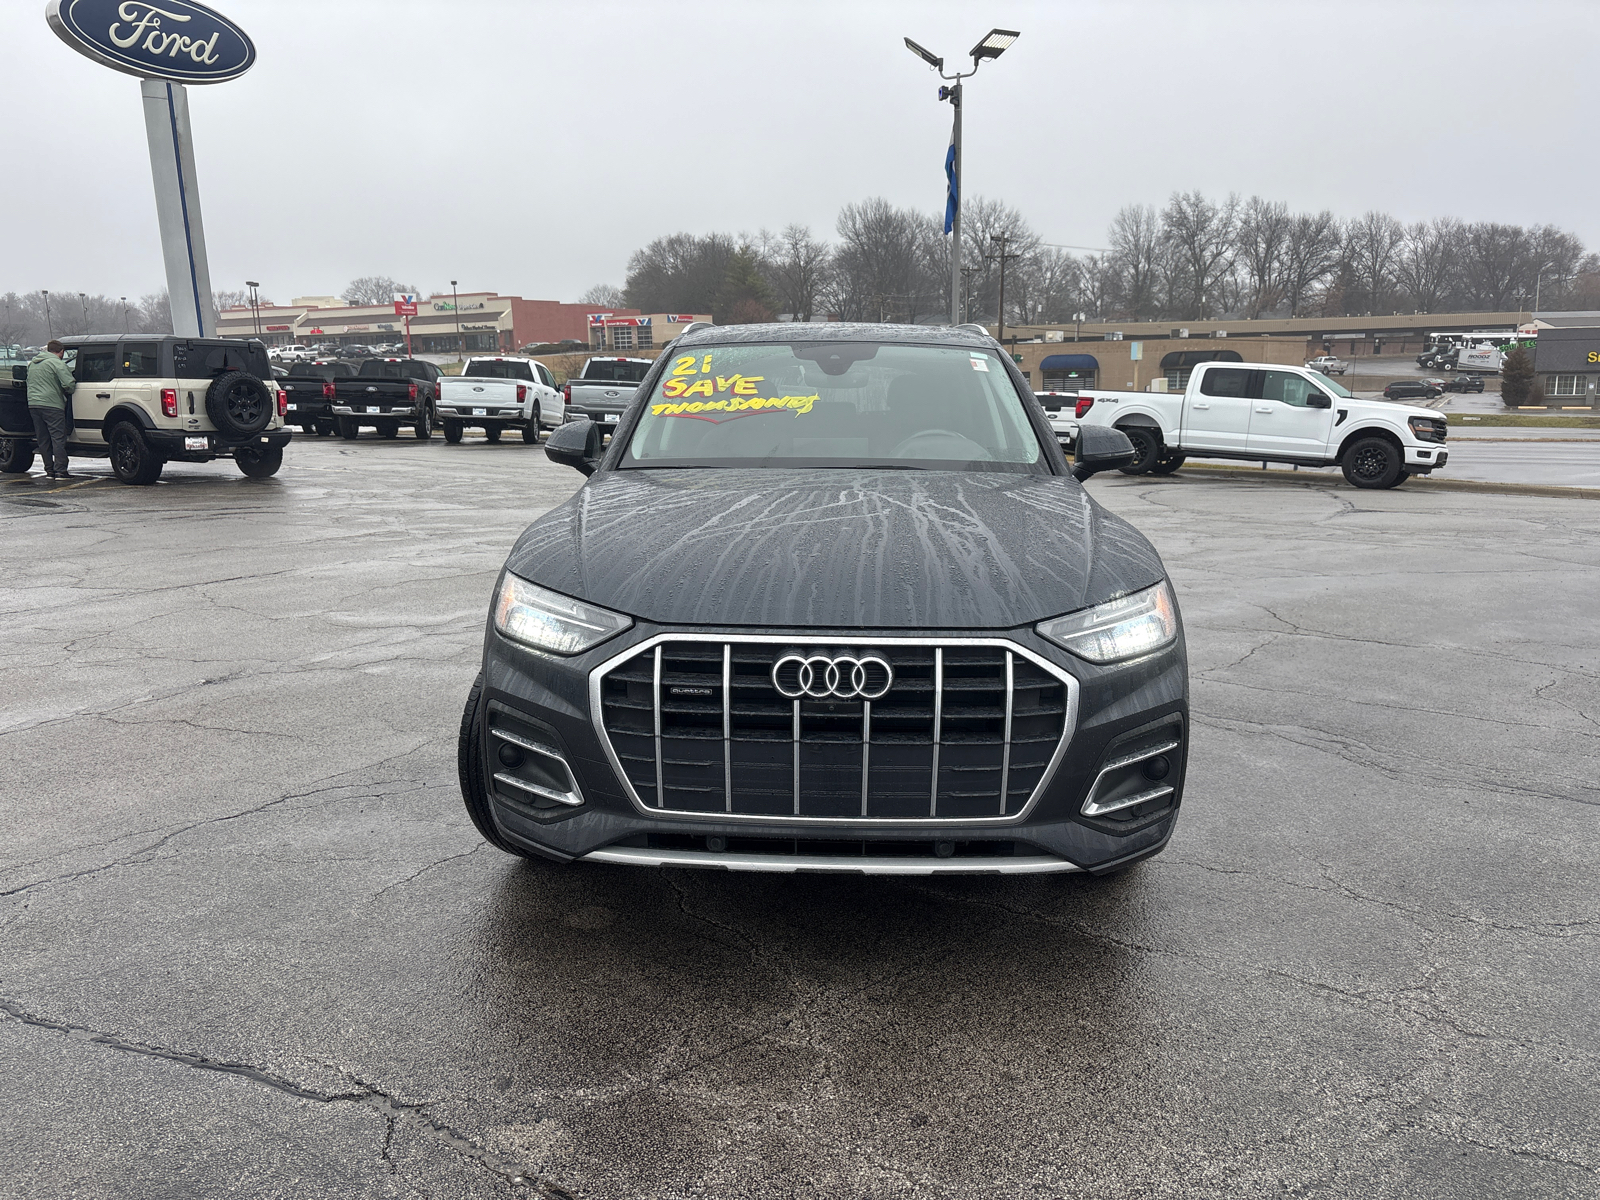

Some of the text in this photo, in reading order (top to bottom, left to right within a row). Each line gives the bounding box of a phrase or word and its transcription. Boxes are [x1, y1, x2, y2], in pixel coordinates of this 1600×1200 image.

[109, 1, 219, 65] Ford
[672, 354, 713, 376] 21
[662, 373, 764, 398] SAVE
